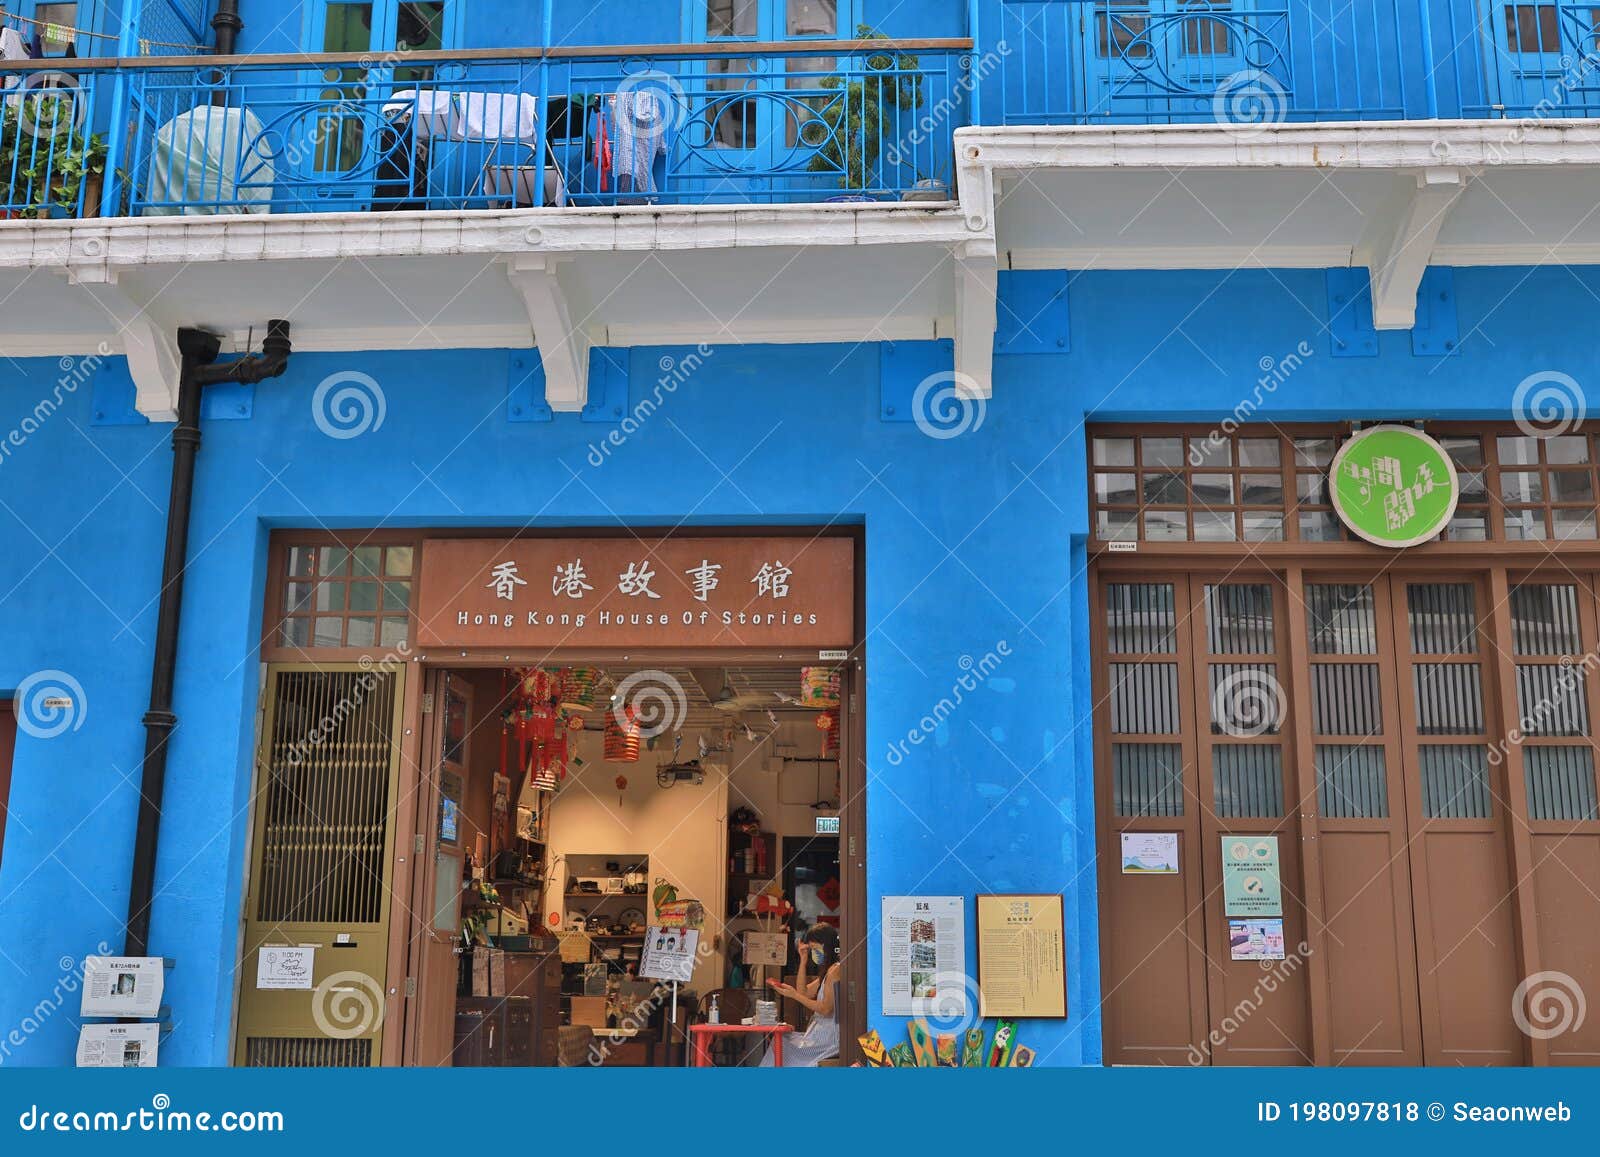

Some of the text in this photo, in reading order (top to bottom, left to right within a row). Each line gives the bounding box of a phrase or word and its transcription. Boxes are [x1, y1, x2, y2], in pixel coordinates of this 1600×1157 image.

[485, 558, 793, 602] 香港故事館
[457, 610, 818, 628] Hong Kong House Of Stories
